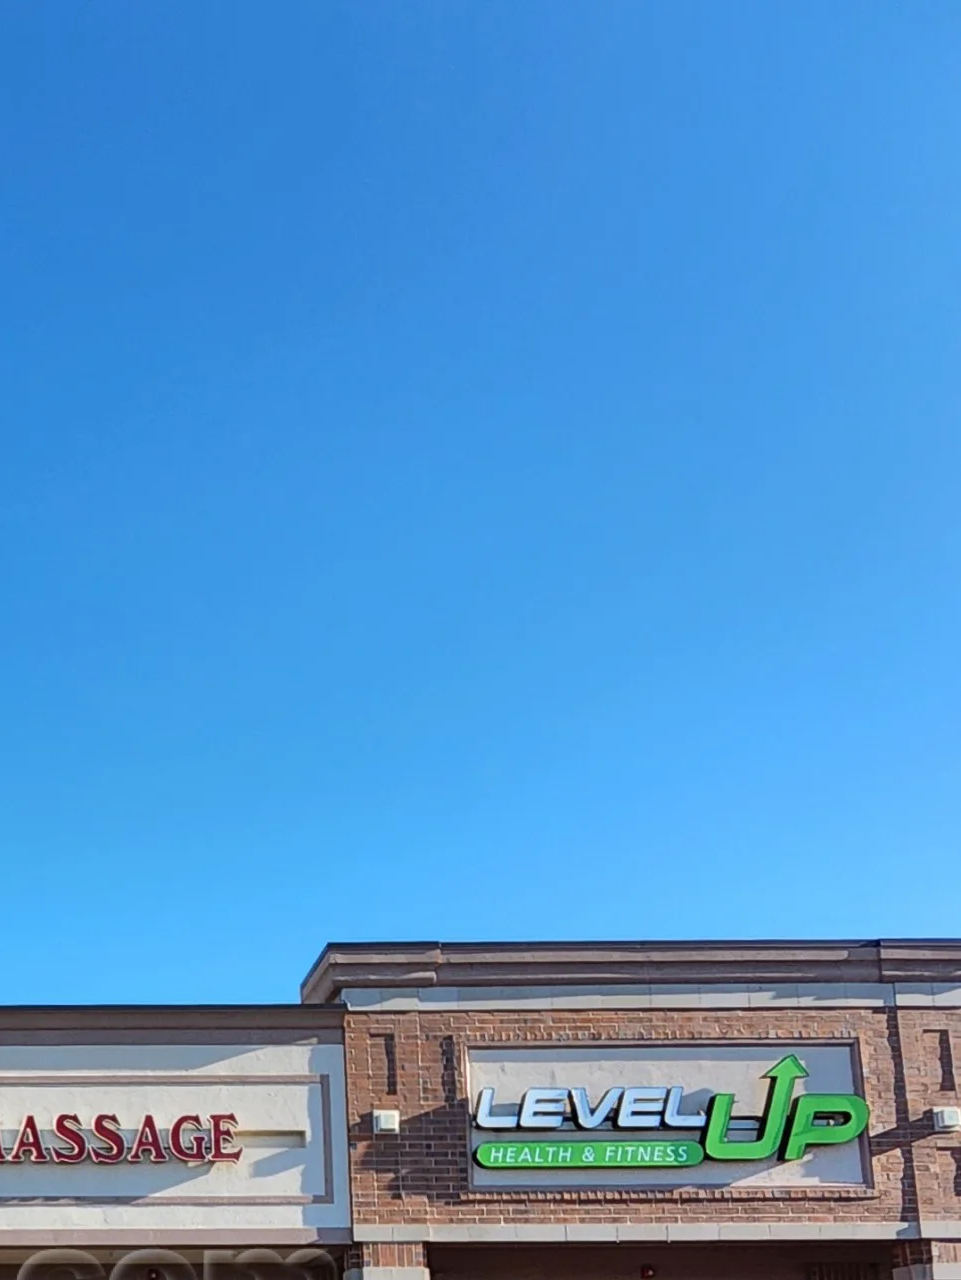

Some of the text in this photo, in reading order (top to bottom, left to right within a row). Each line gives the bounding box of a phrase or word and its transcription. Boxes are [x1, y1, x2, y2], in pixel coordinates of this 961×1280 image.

[475, 1053, 870, 1161] LEVEL UP
[490, 1145, 689, 1164] HEALTH & FITNESS
